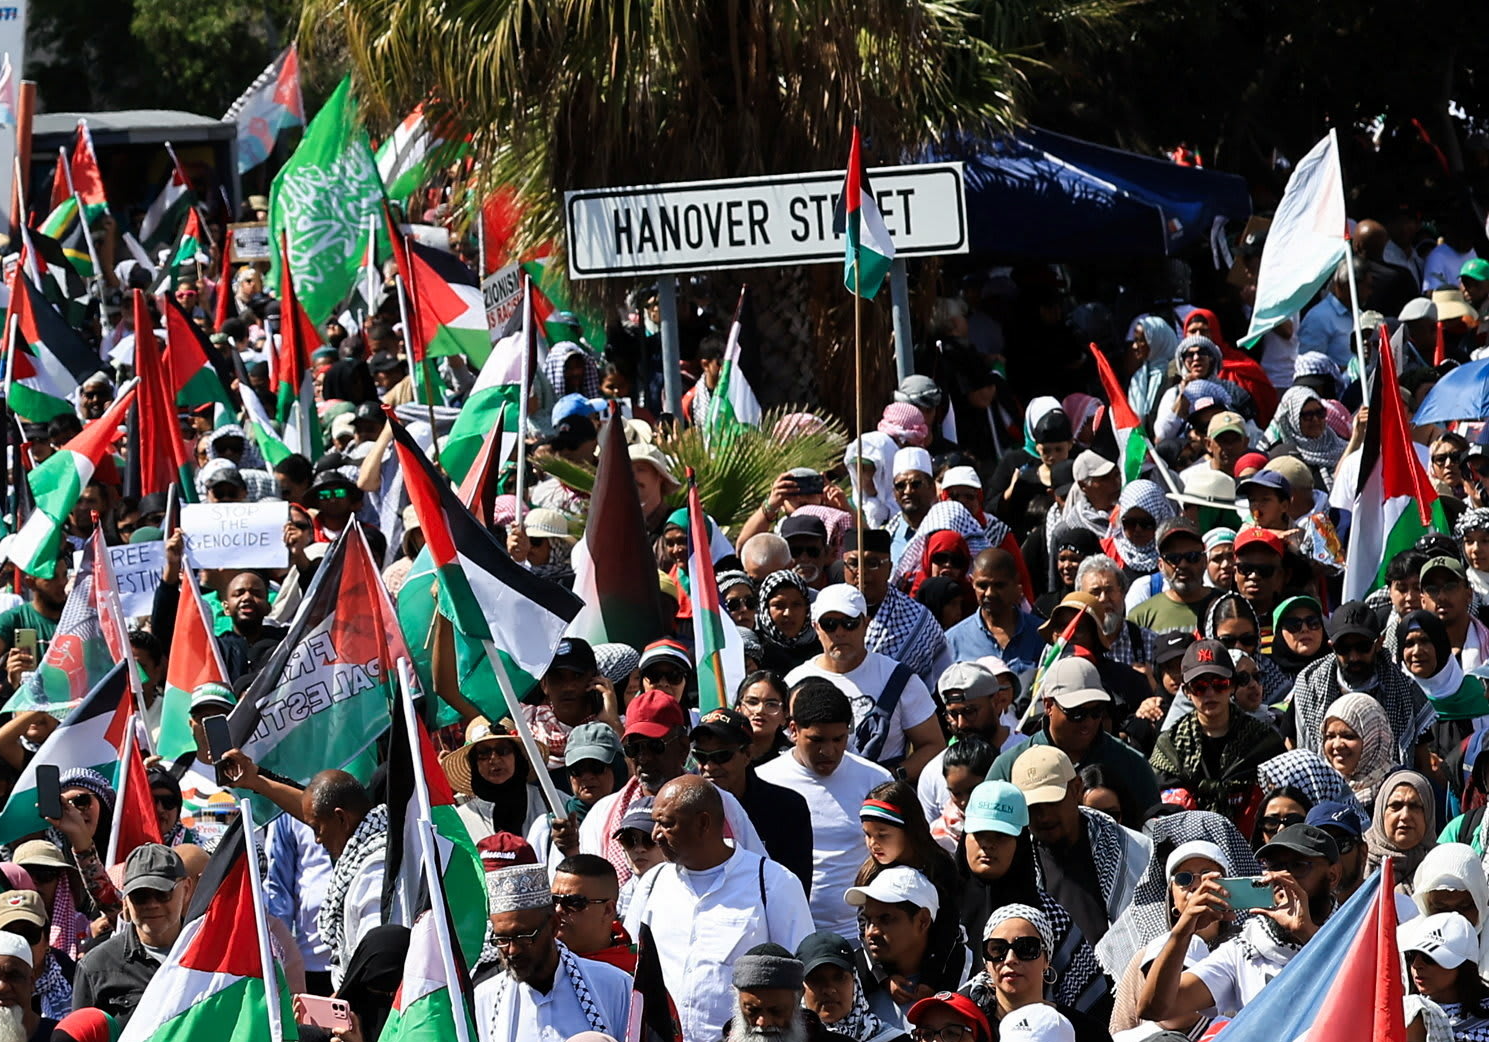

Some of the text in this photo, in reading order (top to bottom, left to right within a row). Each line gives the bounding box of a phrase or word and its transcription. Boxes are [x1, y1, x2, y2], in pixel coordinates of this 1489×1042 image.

[613, 189, 915, 254] HANOVER STET
[212, 504, 259, 520] STOP
[219, 519, 249, 531] THE
[186, 531, 270, 552] GENOCIDE
[111, 544, 151, 568] REE
[116, 569, 163, 594] ESTIN
[700, 709, 731, 724] GUCCI
